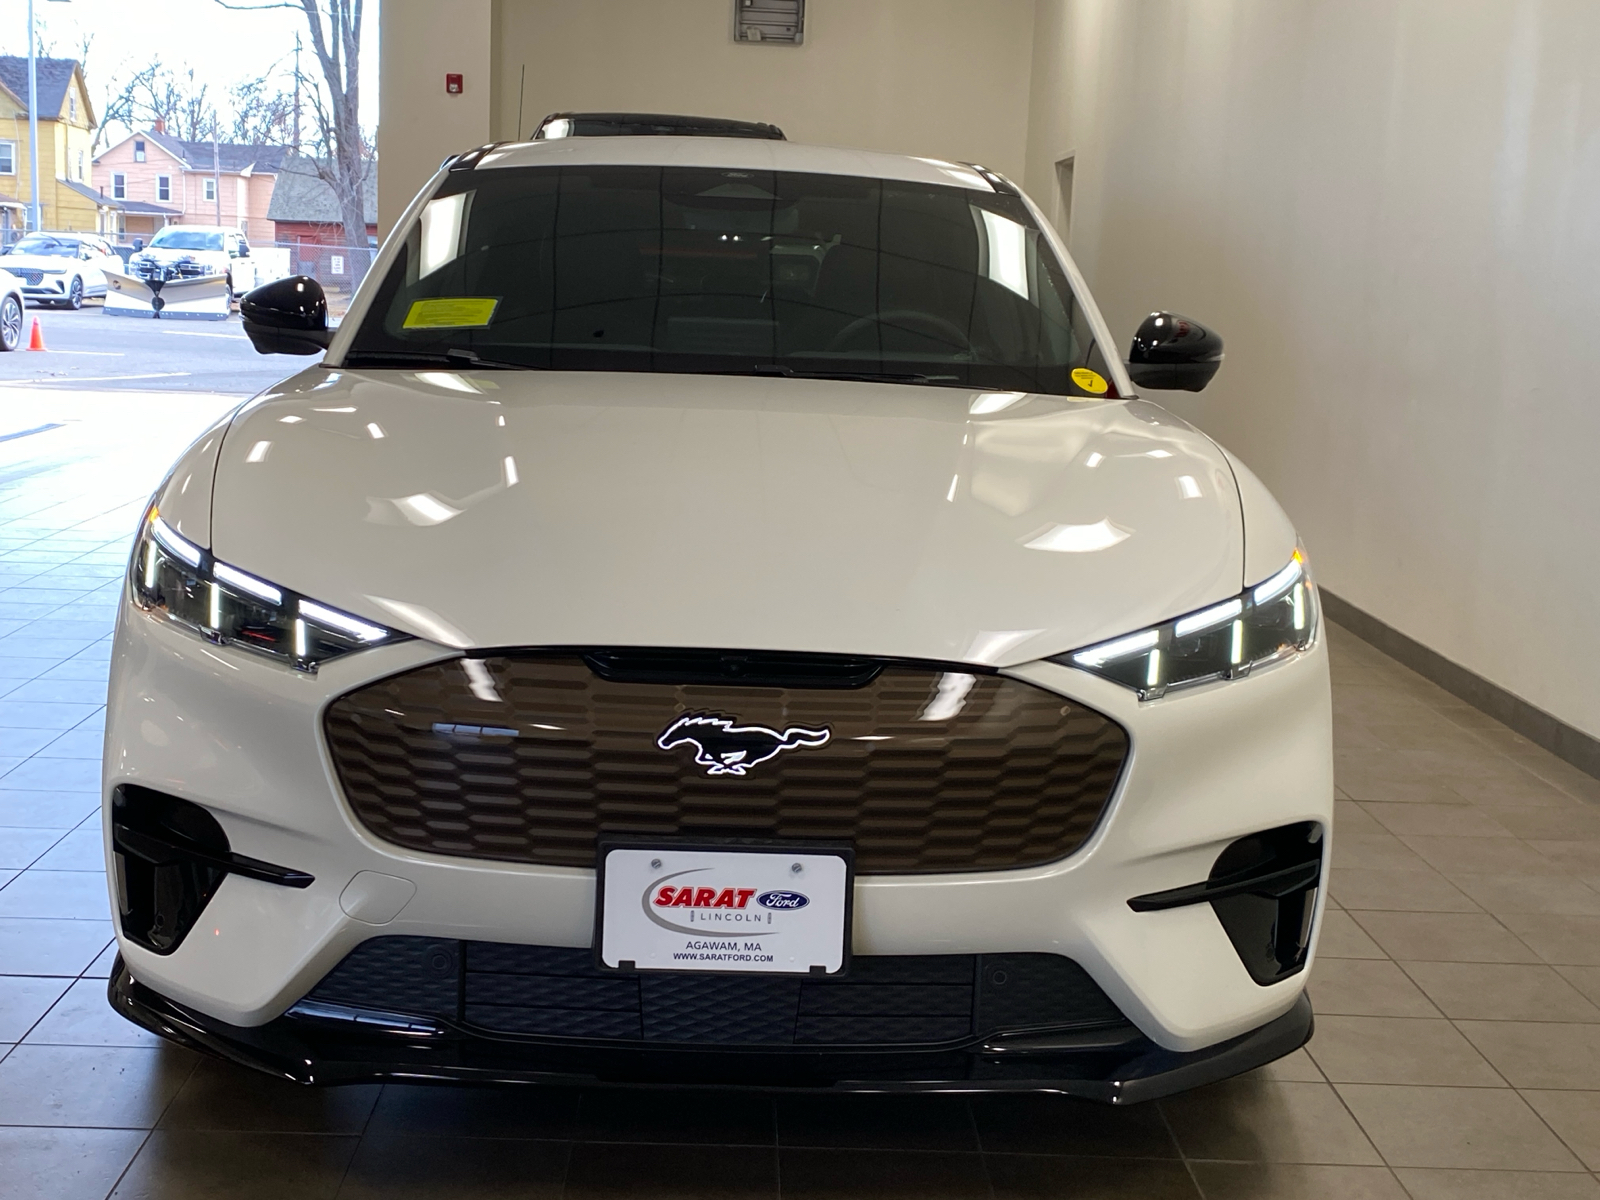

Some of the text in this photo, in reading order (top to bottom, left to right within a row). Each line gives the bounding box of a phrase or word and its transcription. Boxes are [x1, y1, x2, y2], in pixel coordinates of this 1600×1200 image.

[653, 885, 801, 910] SARAT Ford
[700, 912, 762, 923] LINCOLN
[685, 941, 762, 952] AGAWAM, MA
[673, 952, 774, 963] WWW.SARATFORD.COM
